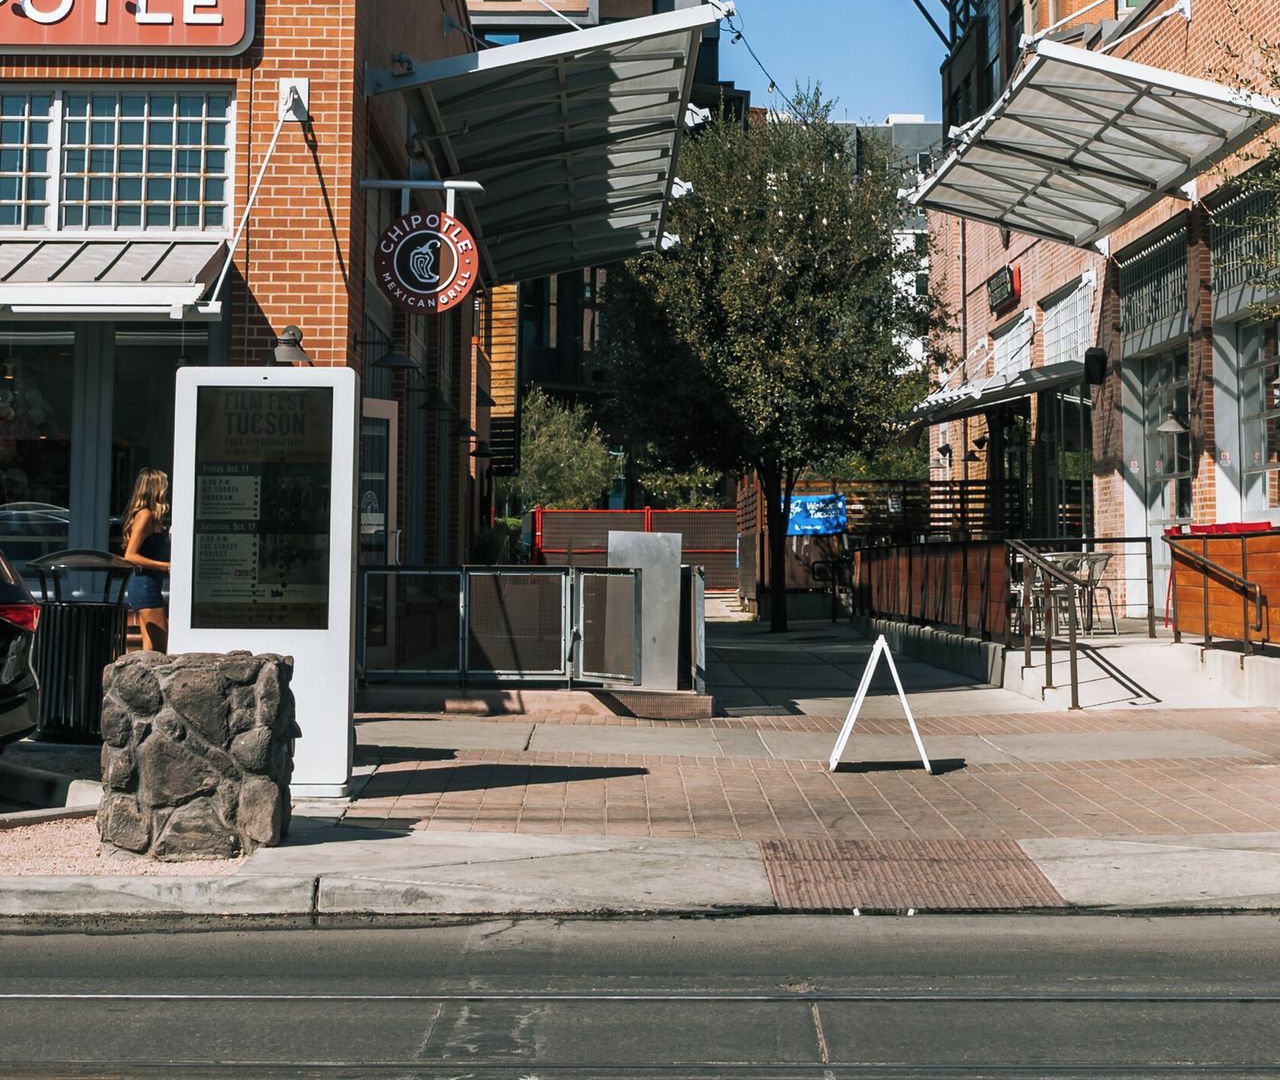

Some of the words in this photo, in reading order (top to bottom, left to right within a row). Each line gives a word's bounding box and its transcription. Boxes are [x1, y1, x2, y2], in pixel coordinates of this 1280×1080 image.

[380, 214, 474, 255] CHIPOTLE
[382, 271, 437, 308] MEXICAN
[439, 271, 471, 306] GRILL
[224, 412, 305, 435] TUCSON
